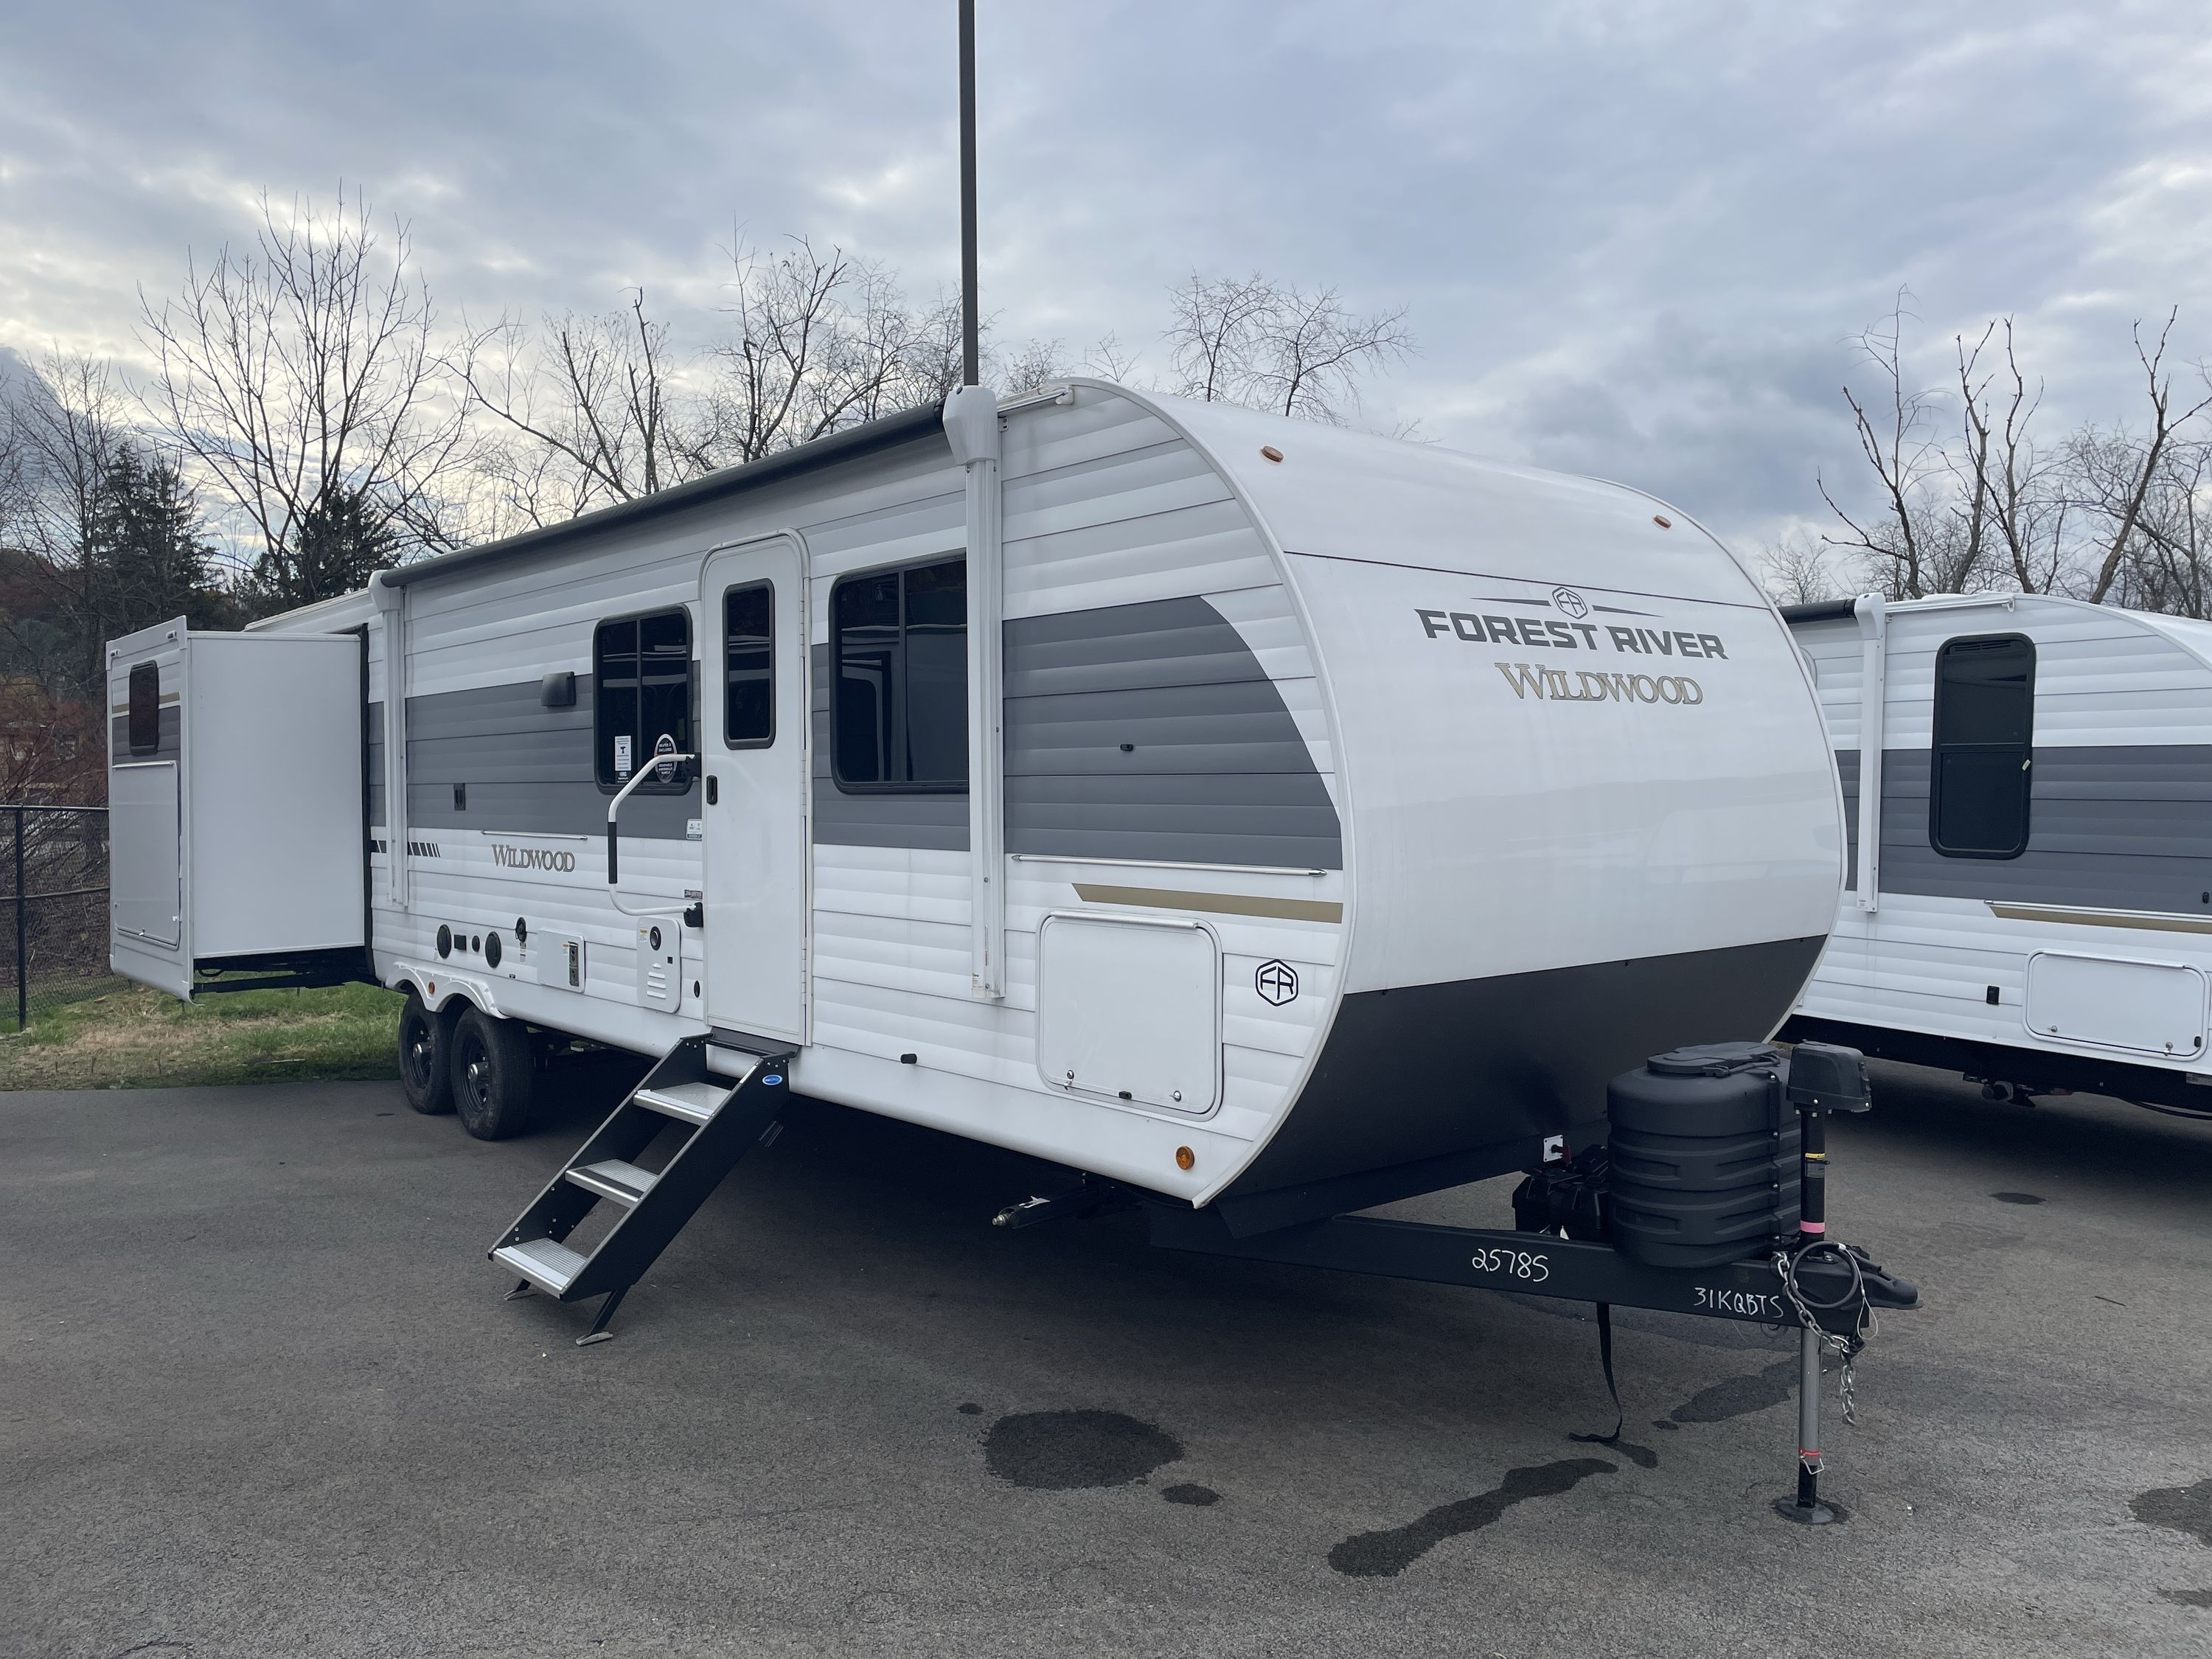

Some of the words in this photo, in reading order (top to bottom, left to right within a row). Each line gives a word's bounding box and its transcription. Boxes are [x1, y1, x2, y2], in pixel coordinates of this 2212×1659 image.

[1413, 608, 1599, 651] FOREST
[1605, 625, 1730, 660] RIVER
[1495, 662, 1704, 706] WILDWOOD
[491, 844, 576, 873] WILDWOOD
[1472, 1248, 1549, 1282] 25785
[1693, 1287, 1784, 1319] 31KQBTS
